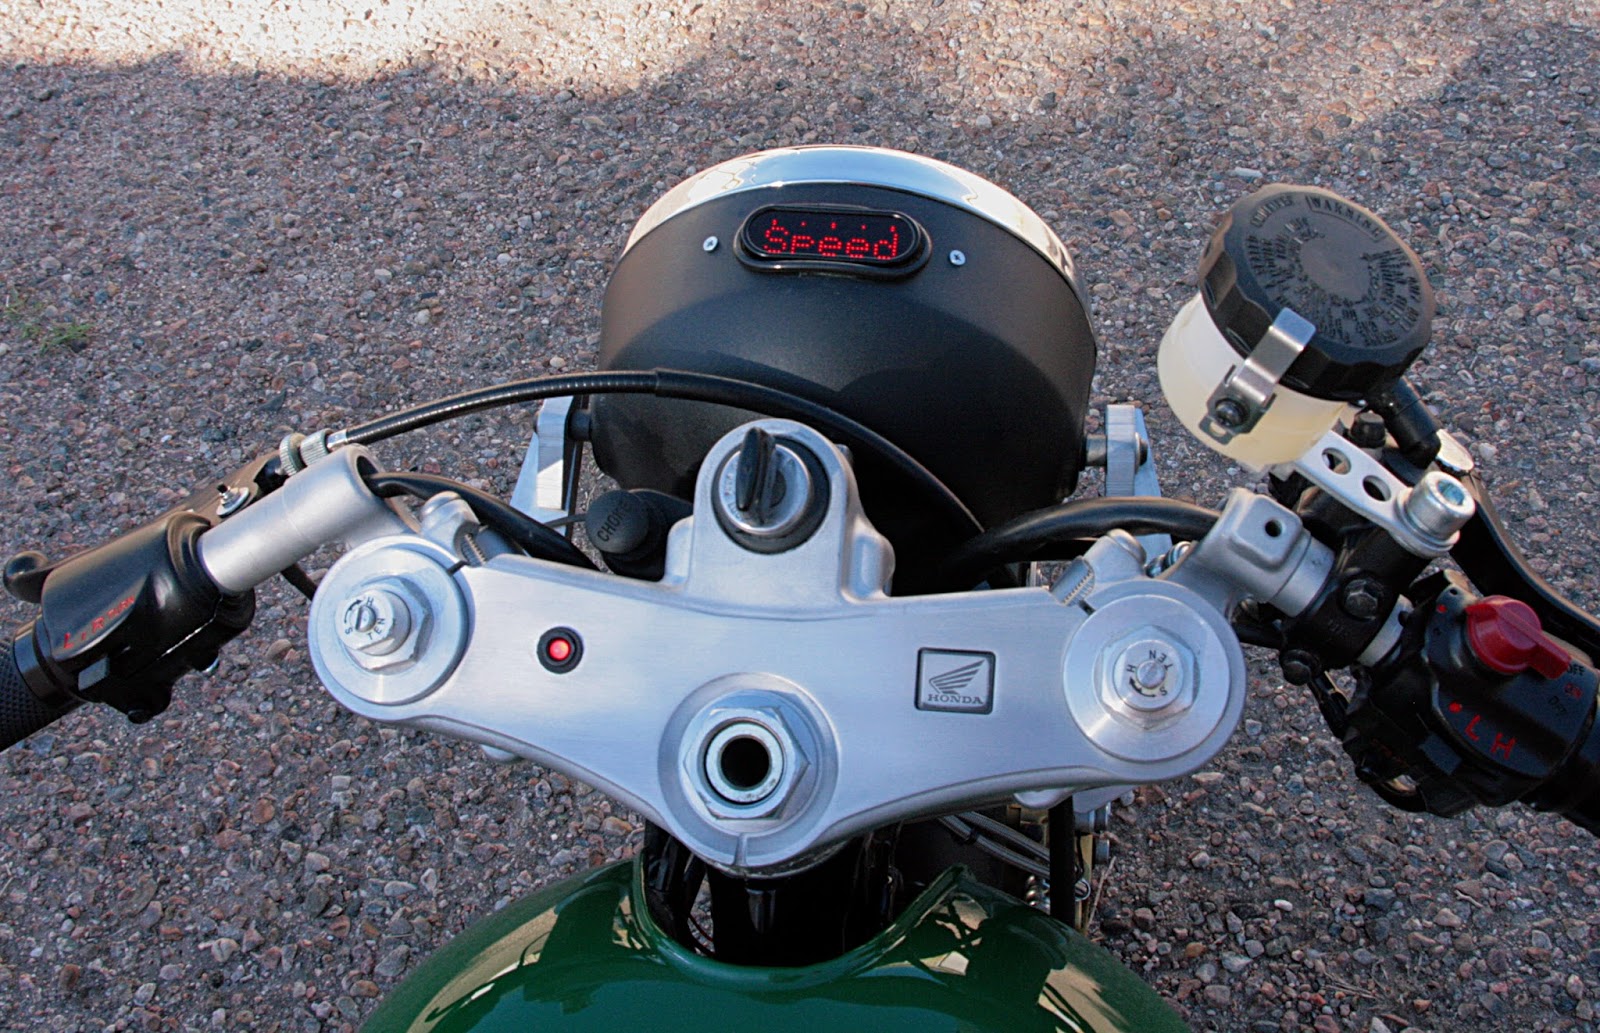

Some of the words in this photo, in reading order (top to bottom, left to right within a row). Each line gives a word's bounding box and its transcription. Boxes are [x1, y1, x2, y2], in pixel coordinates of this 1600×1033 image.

[1312, 195, 1383, 239] WARNING
[763, 226, 899, 261] Speed
[928, 693, 984, 705] HONDA
[1490, 732, 1516, 759] H
